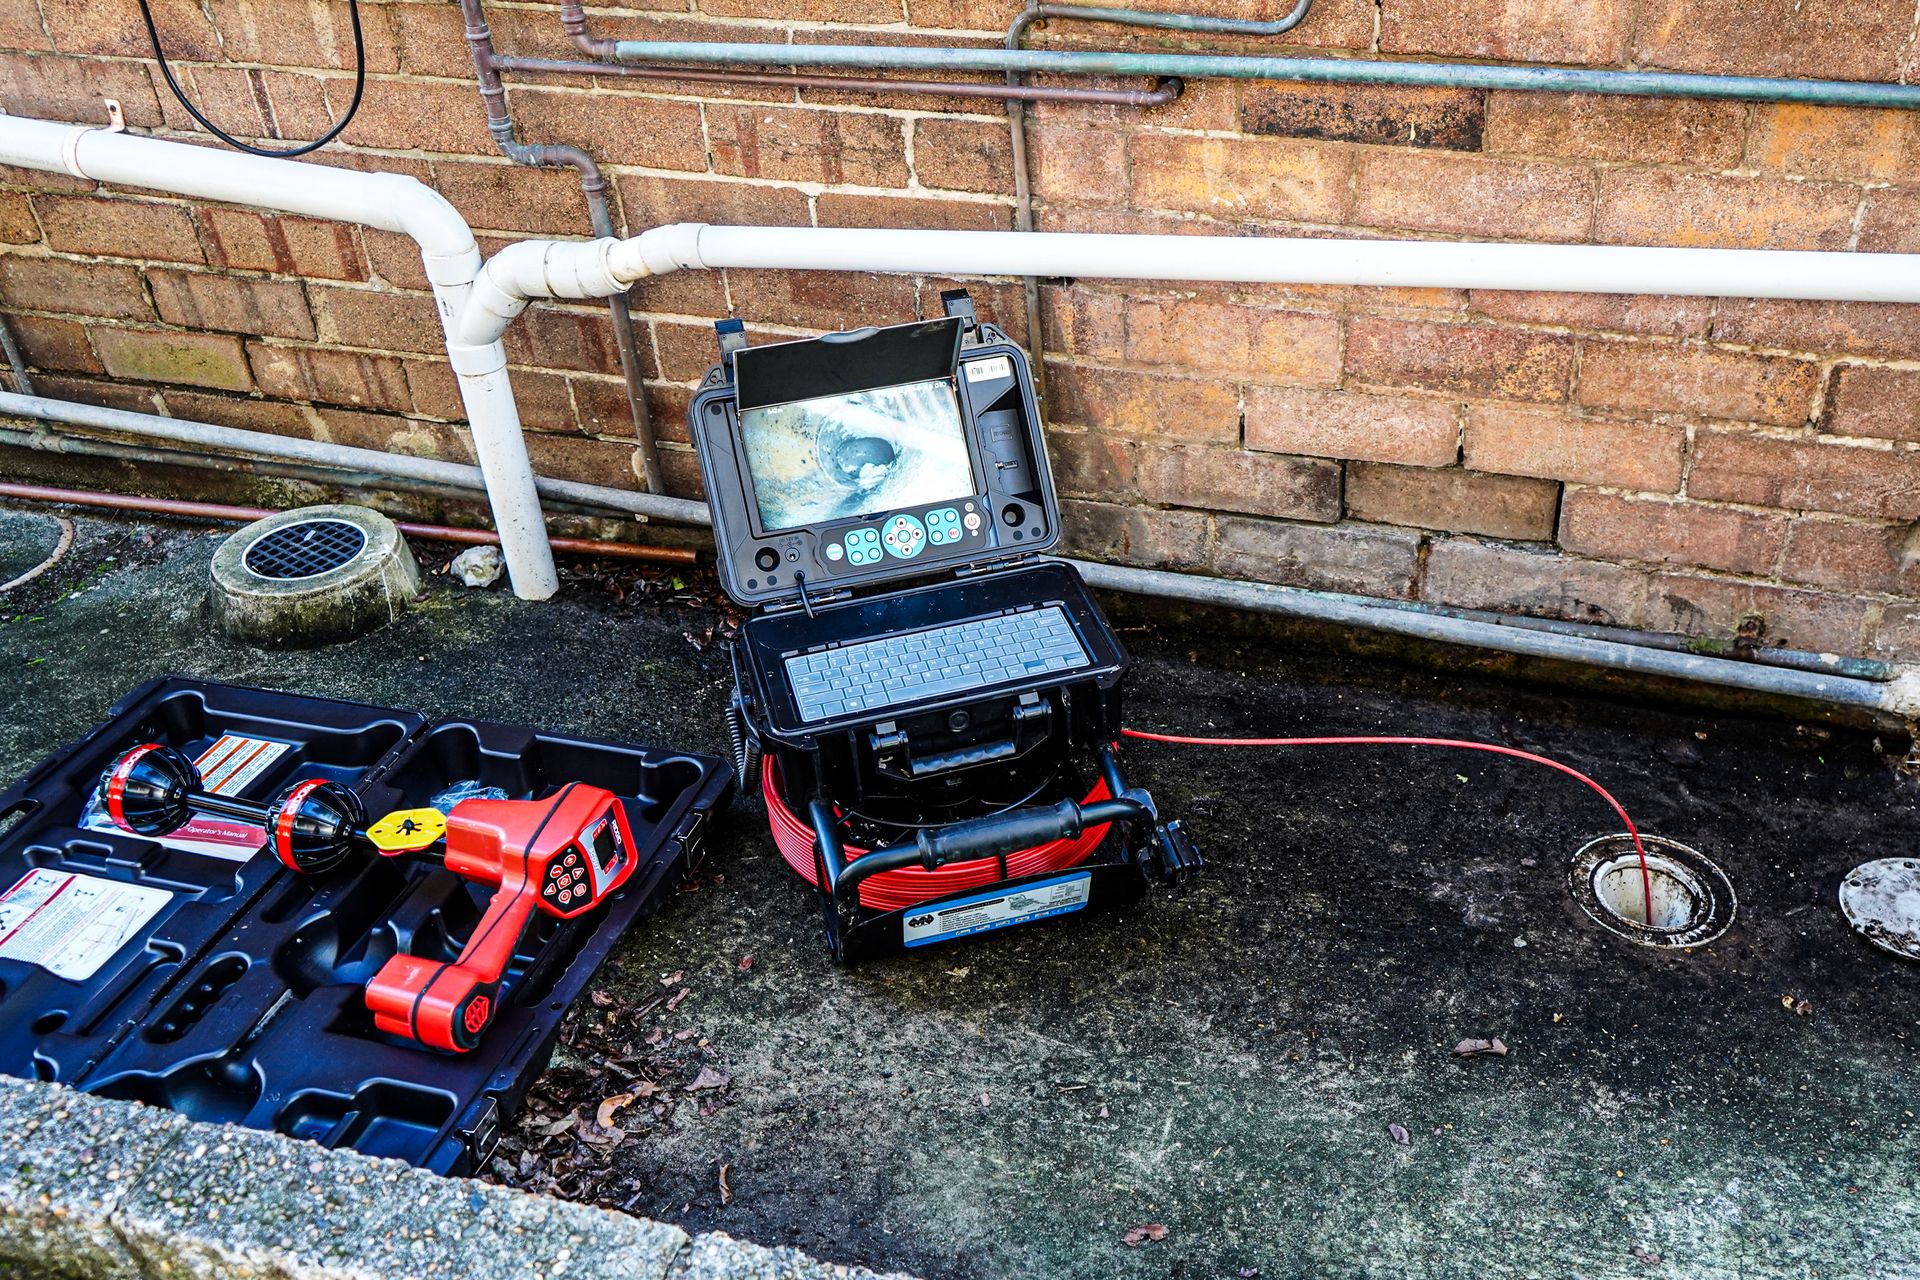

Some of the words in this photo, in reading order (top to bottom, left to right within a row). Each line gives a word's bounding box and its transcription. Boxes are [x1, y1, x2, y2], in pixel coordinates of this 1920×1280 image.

[118, 748, 150, 778] RIDGID
[287, 784, 317, 815] RIDGID
[187, 826, 221, 835] Operator's
[222, 830, 248, 838] Manual
[611, 819, 622, 844] RIDGID
